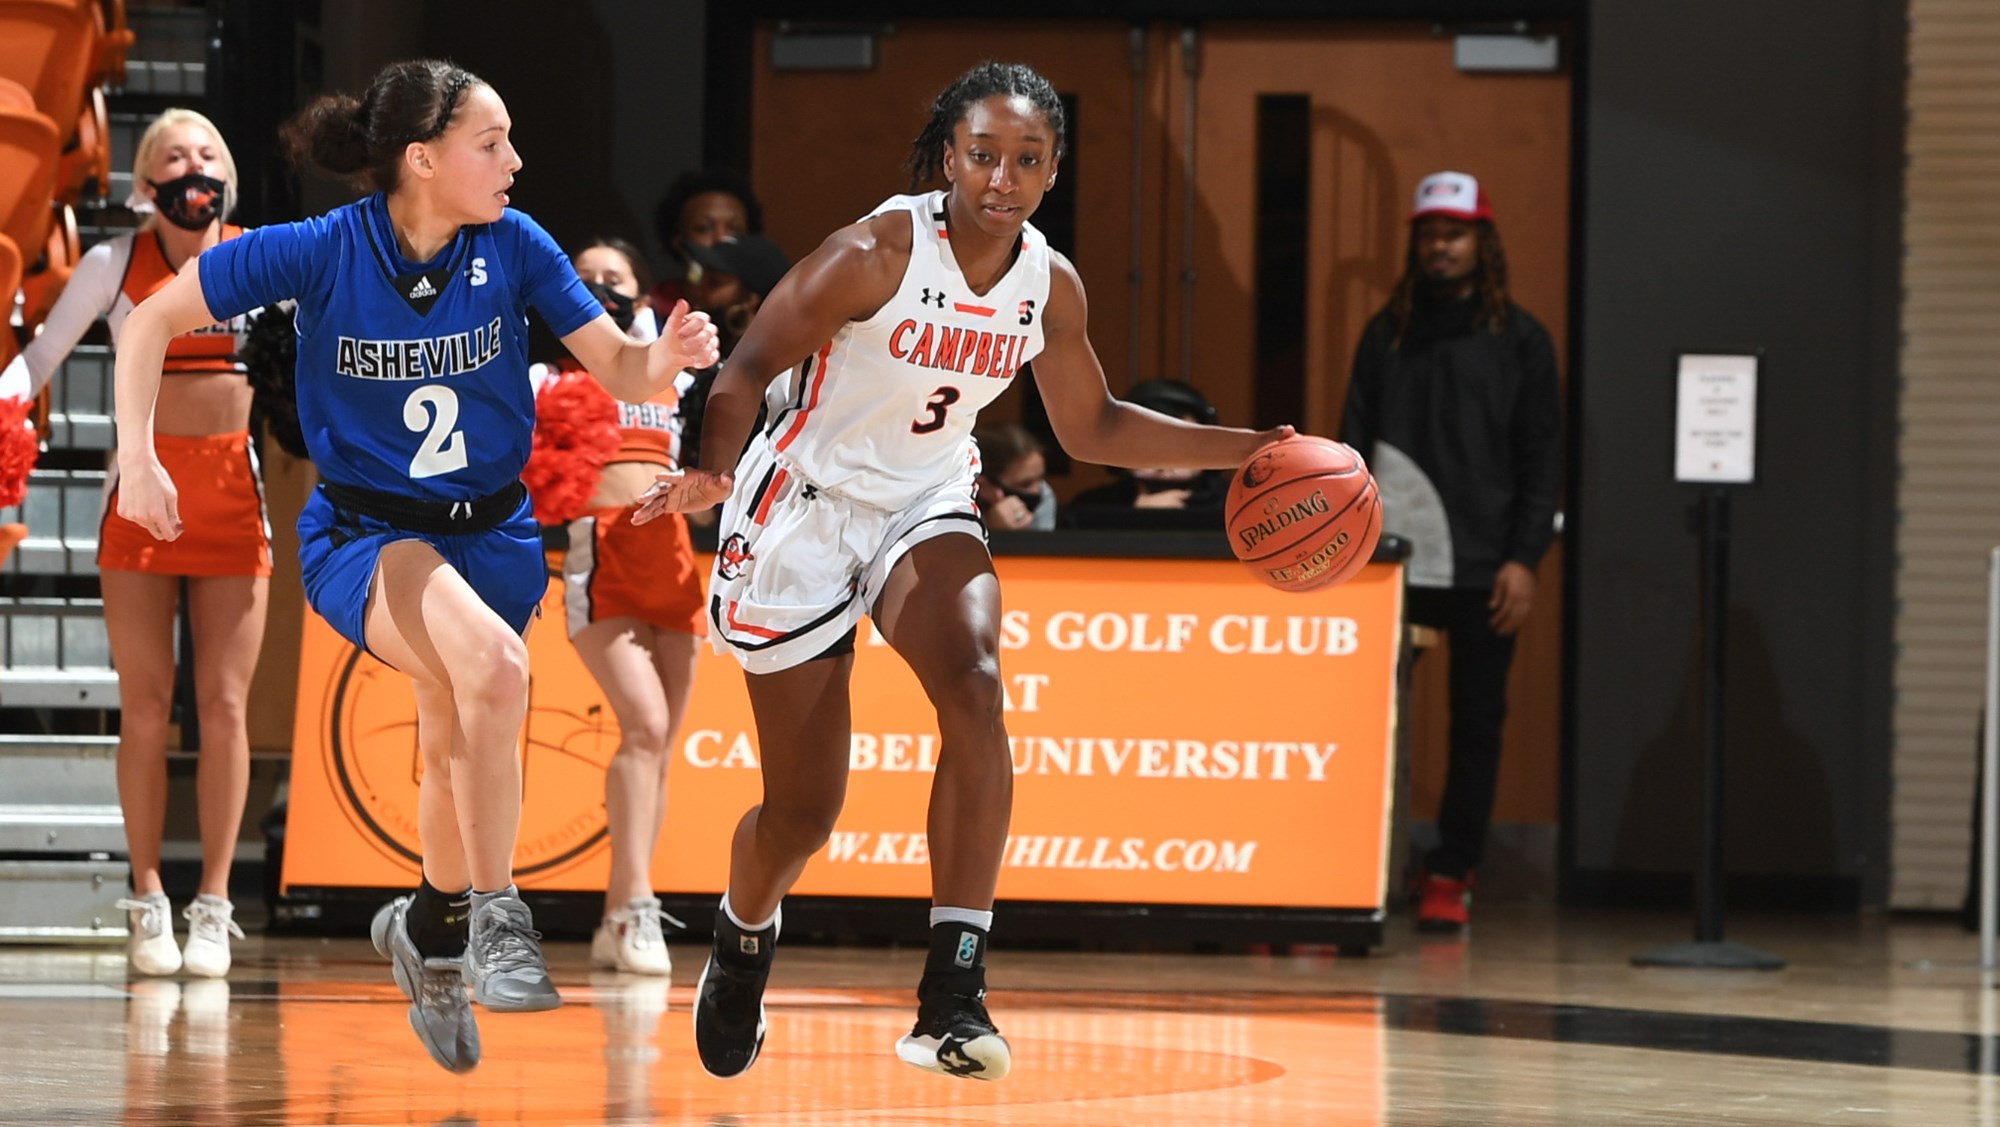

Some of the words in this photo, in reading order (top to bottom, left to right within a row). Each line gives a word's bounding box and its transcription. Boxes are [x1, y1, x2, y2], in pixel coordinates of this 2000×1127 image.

[409, 287, 437, 299] adidas
[336, 316, 501, 381] ASHEVILLE
[403, 384, 468, 478] 2
[911, 386, 961, 435] 3
[1239, 489, 1330, 552] SPALDING
[1045, 611, 1198, 652] GOLF
[1209, 615, 1359, 656] CLUB
[1008, 736, 1338, 781] UNIVERSITY
